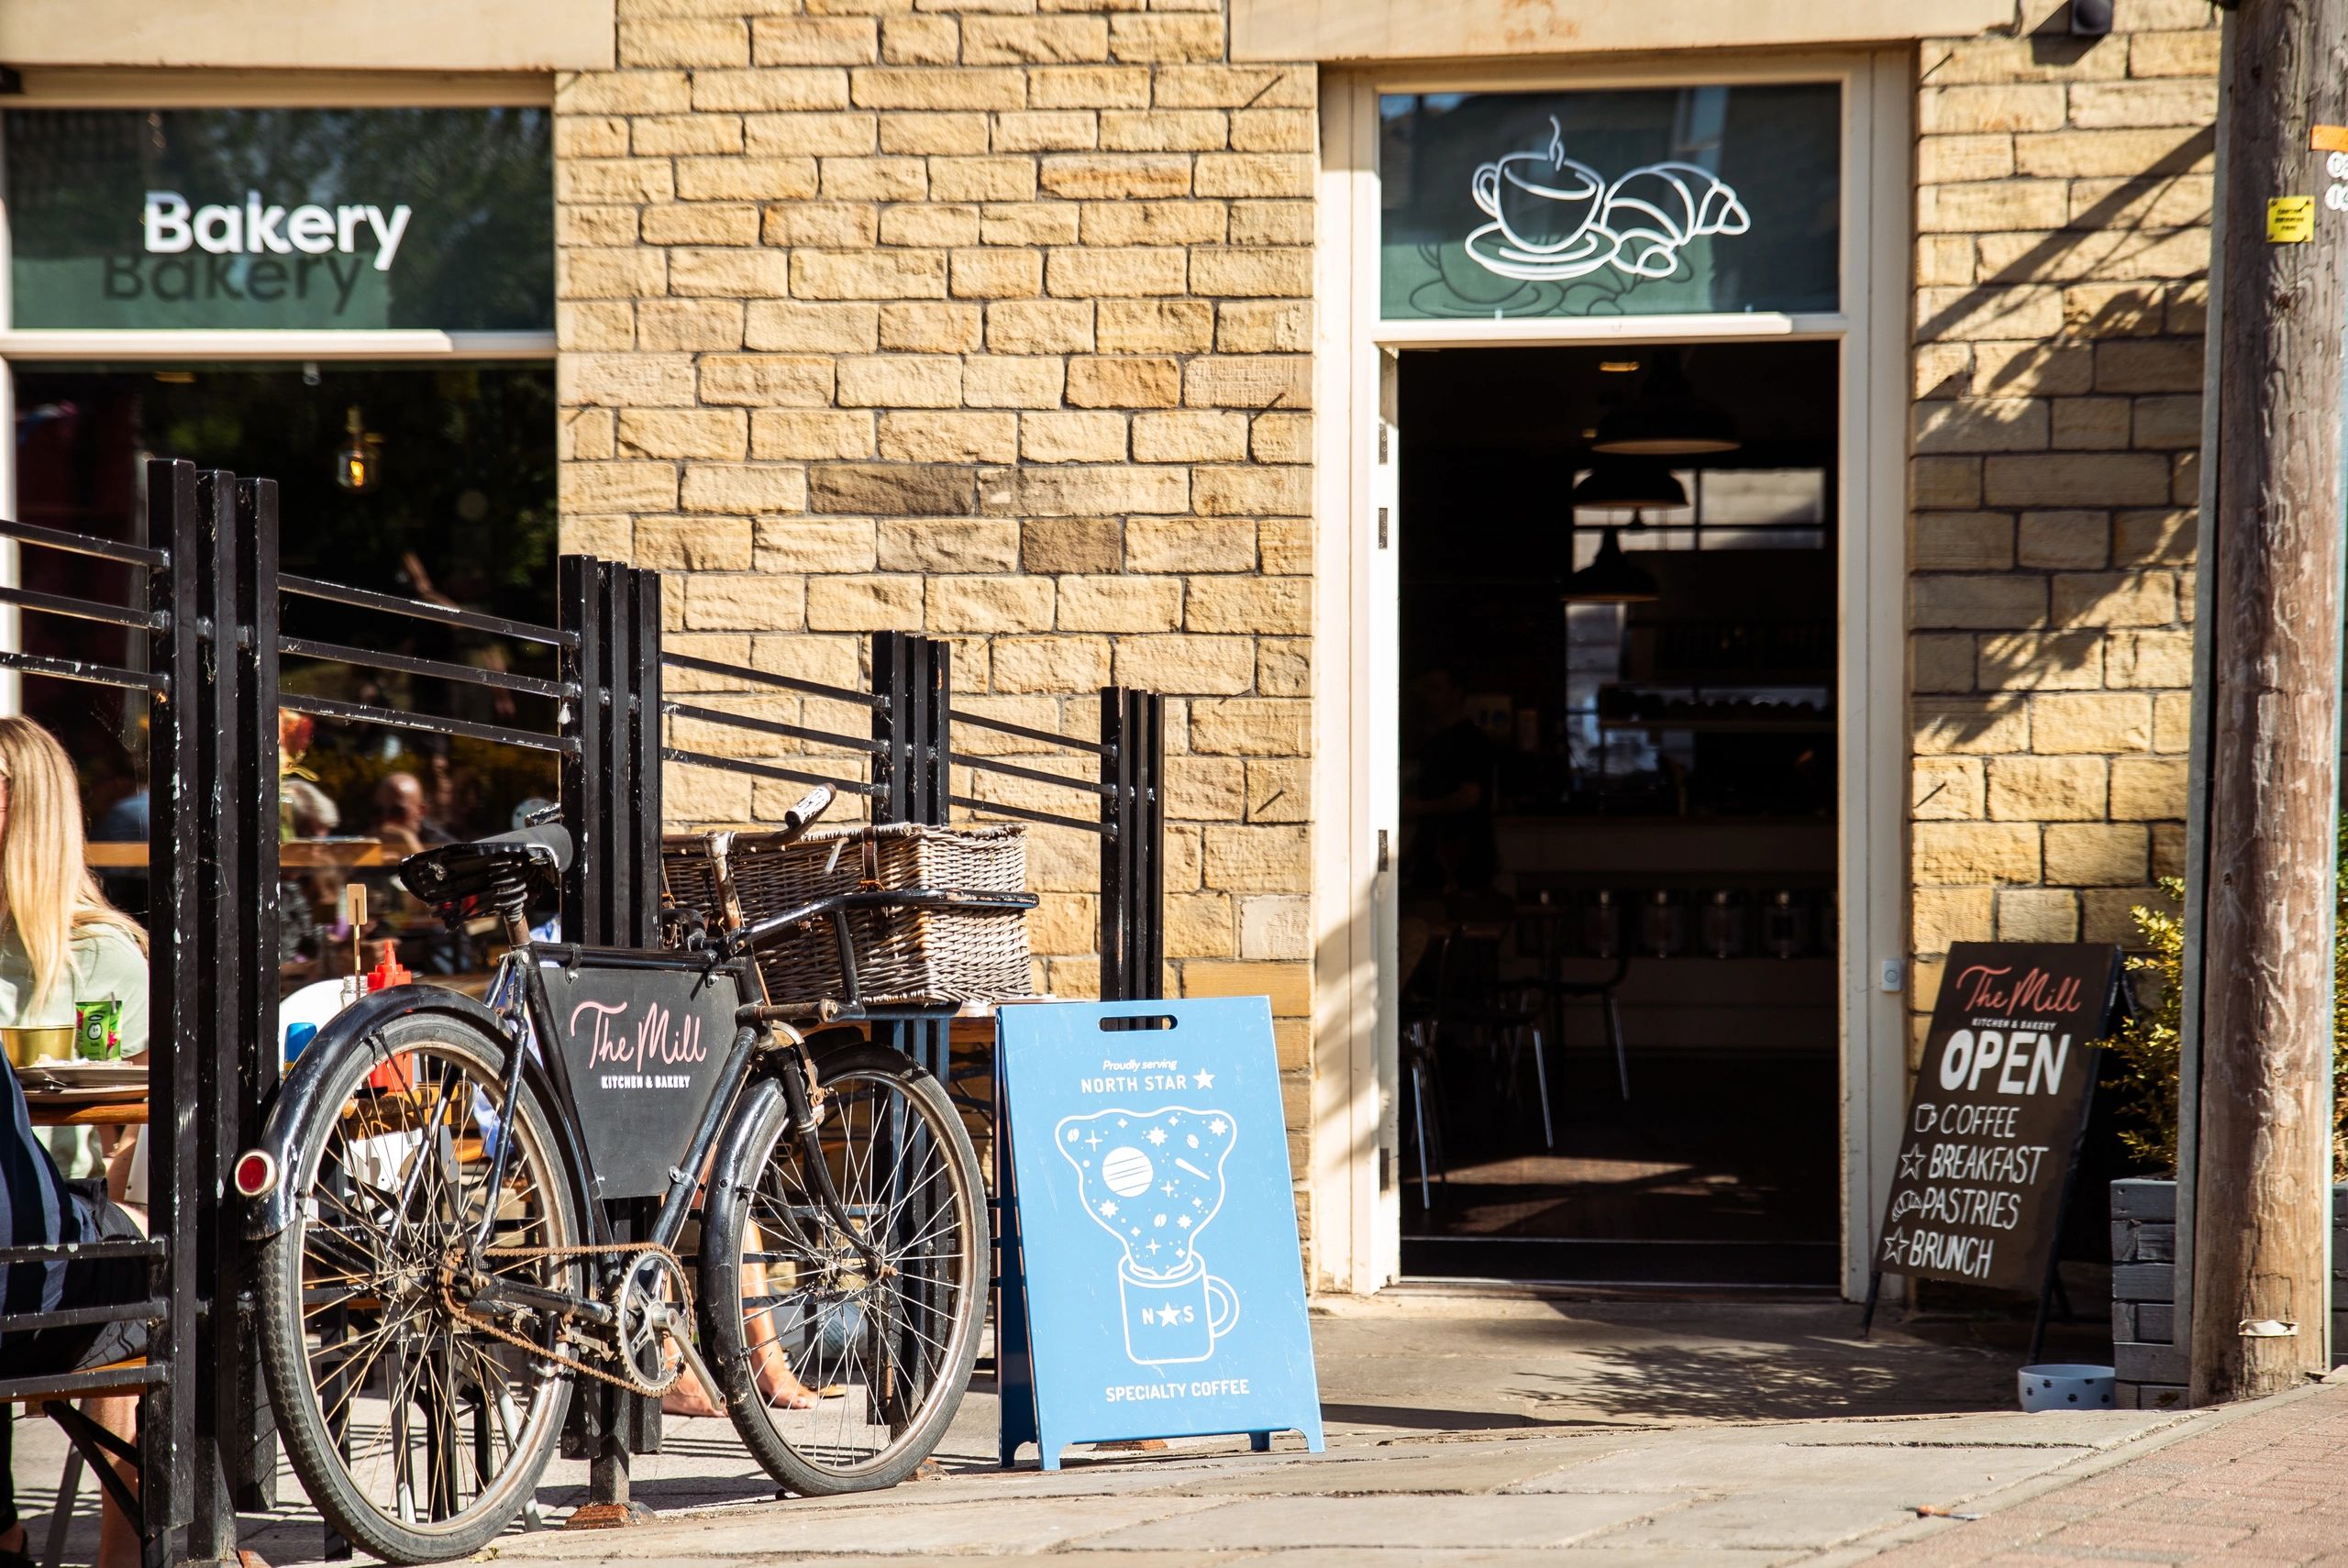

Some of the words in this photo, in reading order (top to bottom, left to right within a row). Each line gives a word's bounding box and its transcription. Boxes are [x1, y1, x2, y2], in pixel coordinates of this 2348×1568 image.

[144, 189, 412, 271] Bakery
[1955, 966, 2012, 1012] The
[2006, 967, 2082, 1016] Mill
[570, 1001, 635, 1069] The
[637, 1002, 707, 1073] Mill
[1972, 1018, 2010, 1029] KITCHEN
[2010, 1020, 2019, 1029] &
[2020, 1020, 2057, 1031] BAKERY
[601, 1075, 643, 1089] KITCHEN
[645, 1075, 654, 1089] &
[655, 1075, 691, 1088] BAKERY
[1102, 1058, 1140, 1072] Proudly
[1141, 1058, 1178, 1071] serving
[1940, 1028, 2072, 1096] OPEN
[1080, 1077, 1138, 1094] NORTH
[1144, 1074, 1187, 1091] STAR
[1940, 1103, 2021, 1138] COFFEE
[1928, 1143, 2050, 1186] BREAKFAST
[1920, 1187, 2021, 1230] PASTRIES
[1908, 1229, 1995, 1279] BRUNCH
[1105, 1383, 1187, 1403] SPECIALTY
[1191, 1379, 1250, 1397] COFFEE
